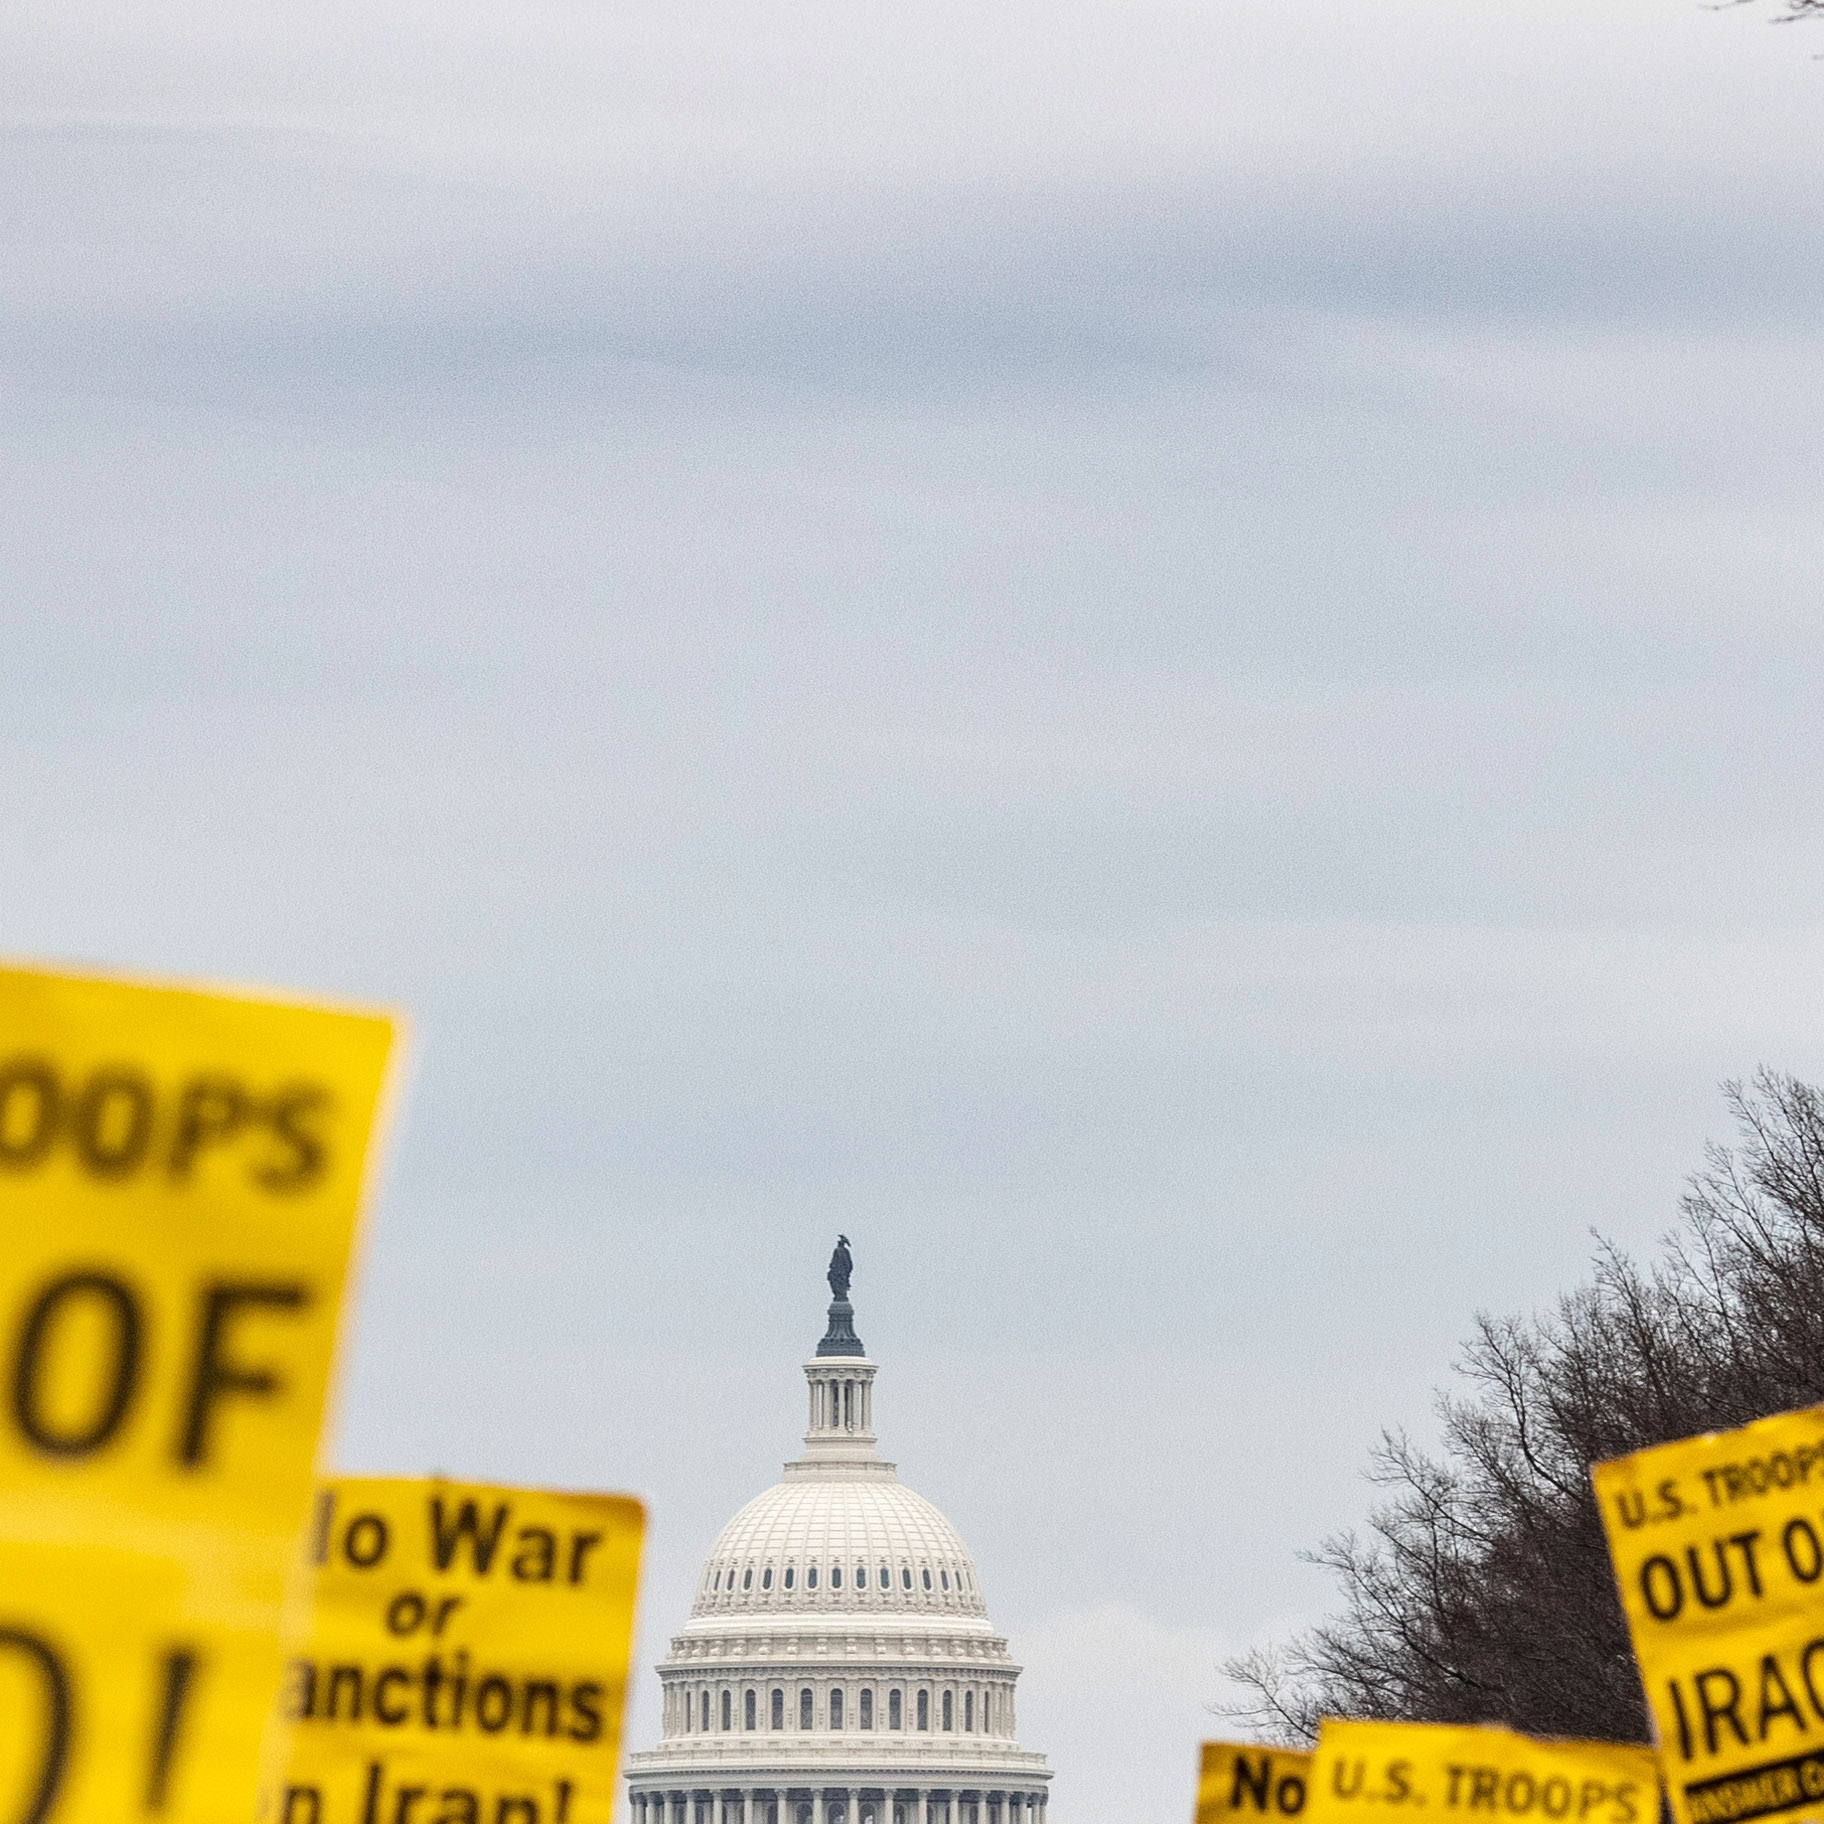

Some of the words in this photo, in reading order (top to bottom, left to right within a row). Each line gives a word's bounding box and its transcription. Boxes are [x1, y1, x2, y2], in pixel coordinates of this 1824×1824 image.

[9, 1259, 319, 1474] OF
[430, 1495, 605, 1586] War
[1615, 1479, 1698, 1530] U.S.
[383, 1588, 462, 1640] or
[1637, 1530, 1763, 1622] OUT
[282, 1650, 606, 1744] anctions
[1230, 1755, 1306, 1816] No
[1330, 1757, 1425, 1807] U.S.
